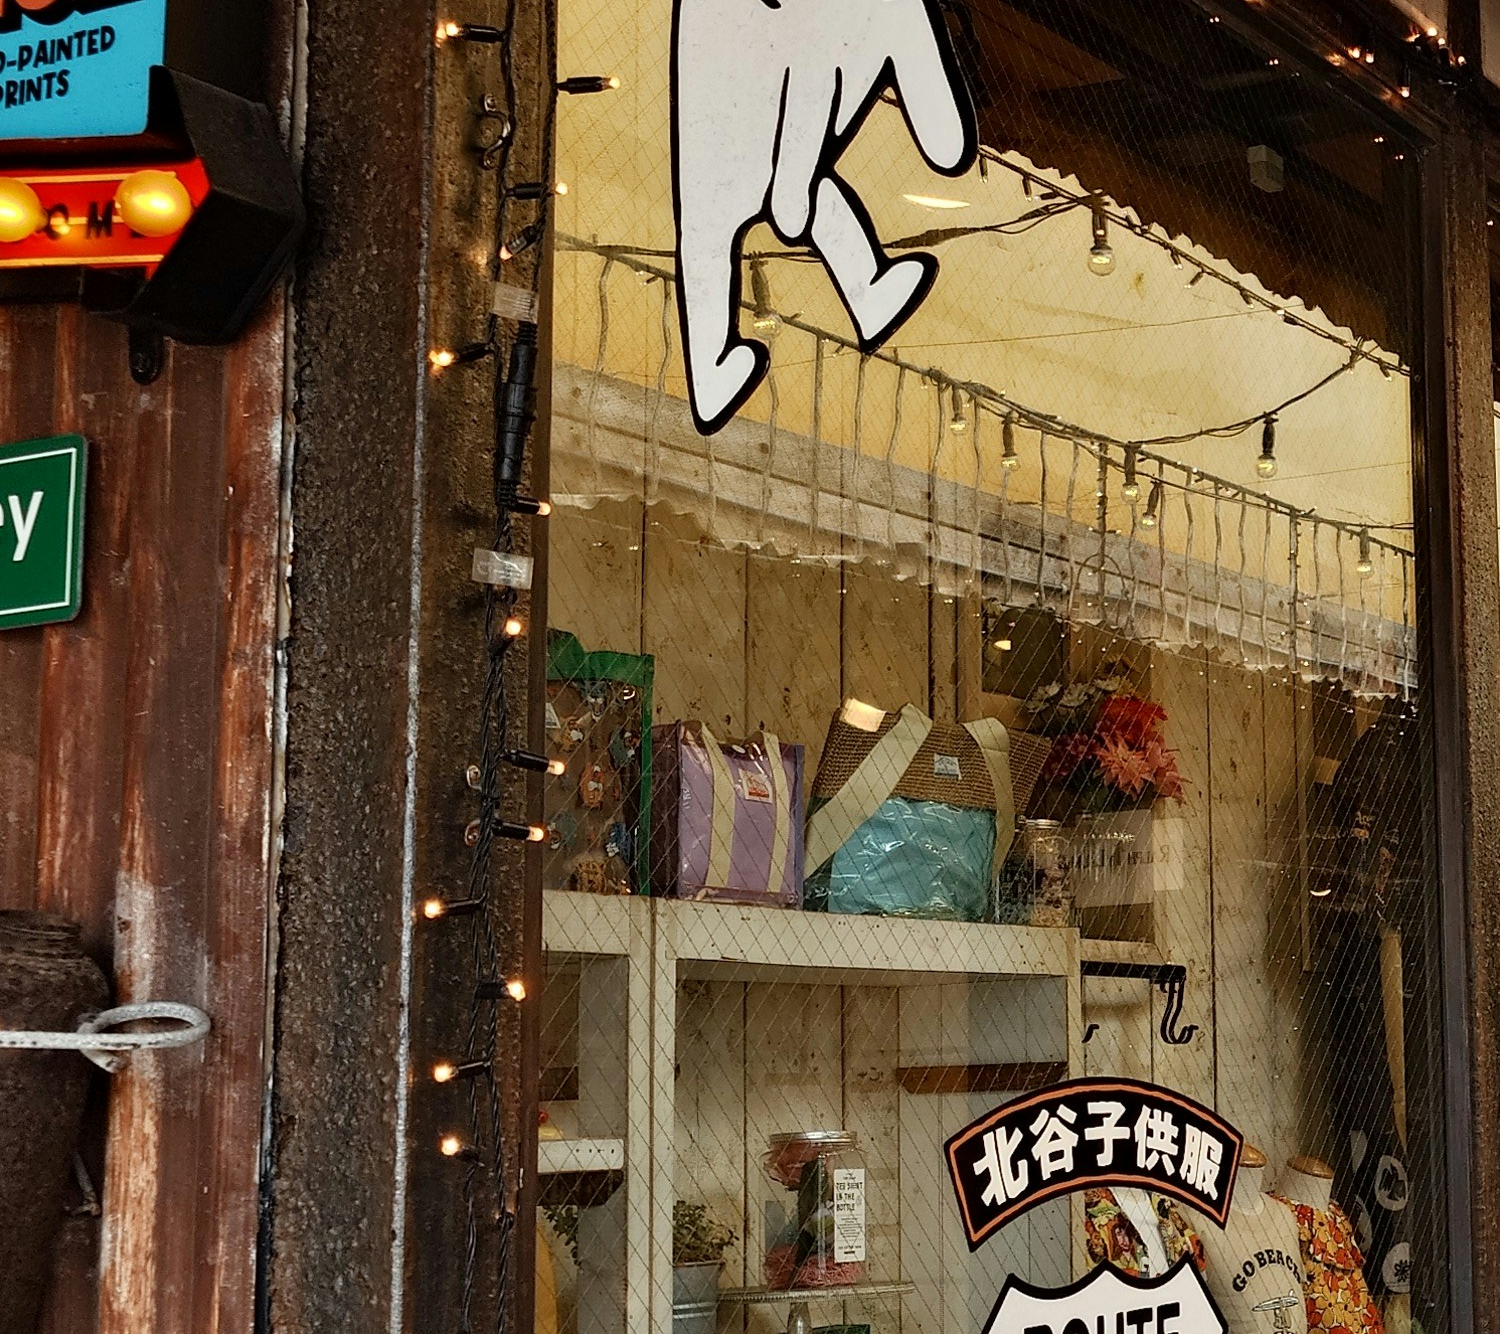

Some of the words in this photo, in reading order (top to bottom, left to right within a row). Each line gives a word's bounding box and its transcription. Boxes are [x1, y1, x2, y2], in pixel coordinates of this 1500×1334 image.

[0, 69, 70, 108] RINTS
[973, 1101, 1223, 1206] 北谷子供服
[1232, 1260, 1256, 1292] GO
